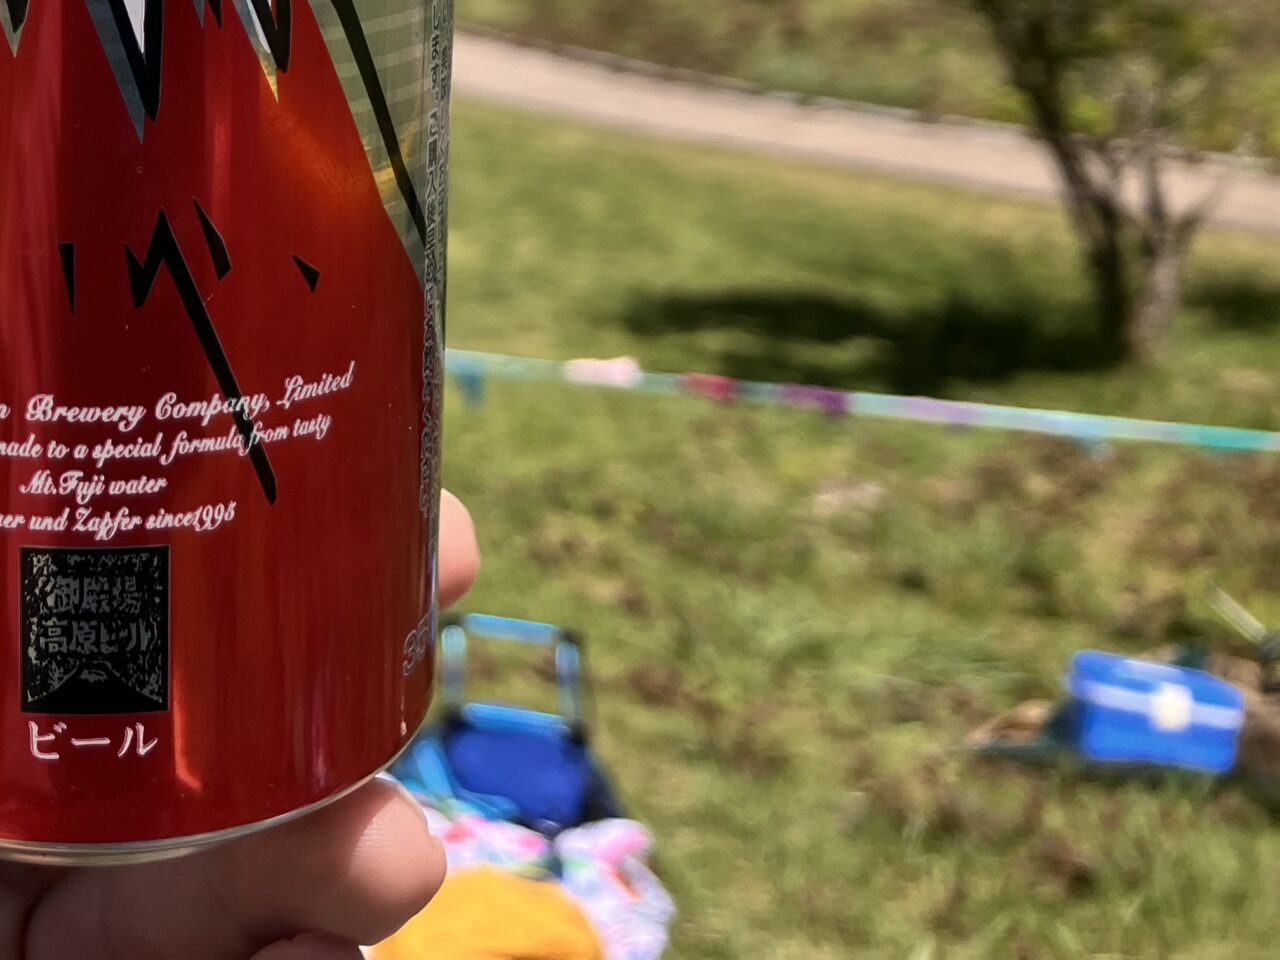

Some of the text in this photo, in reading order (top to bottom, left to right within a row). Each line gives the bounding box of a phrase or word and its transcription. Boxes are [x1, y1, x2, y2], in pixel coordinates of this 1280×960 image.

[25, 393, 147, 432] Brewery
[155, 391, 270, 426] Company,
[276, 360, 356, 409] Limited
[47, 440, 70, 458] to
[73, 444, 89, 458] a
[91, 432, 163, 468] special
[159, 424, 244, 466] formula
[238, 420, 289, 456] from
[293, 412, 332, 440] tasty
[108, 475, 168, 495] water
[28, 507, 70, 531] und
[72, 506, 142, 540] Zapfer
[28, 720, 159, 760] ビール
